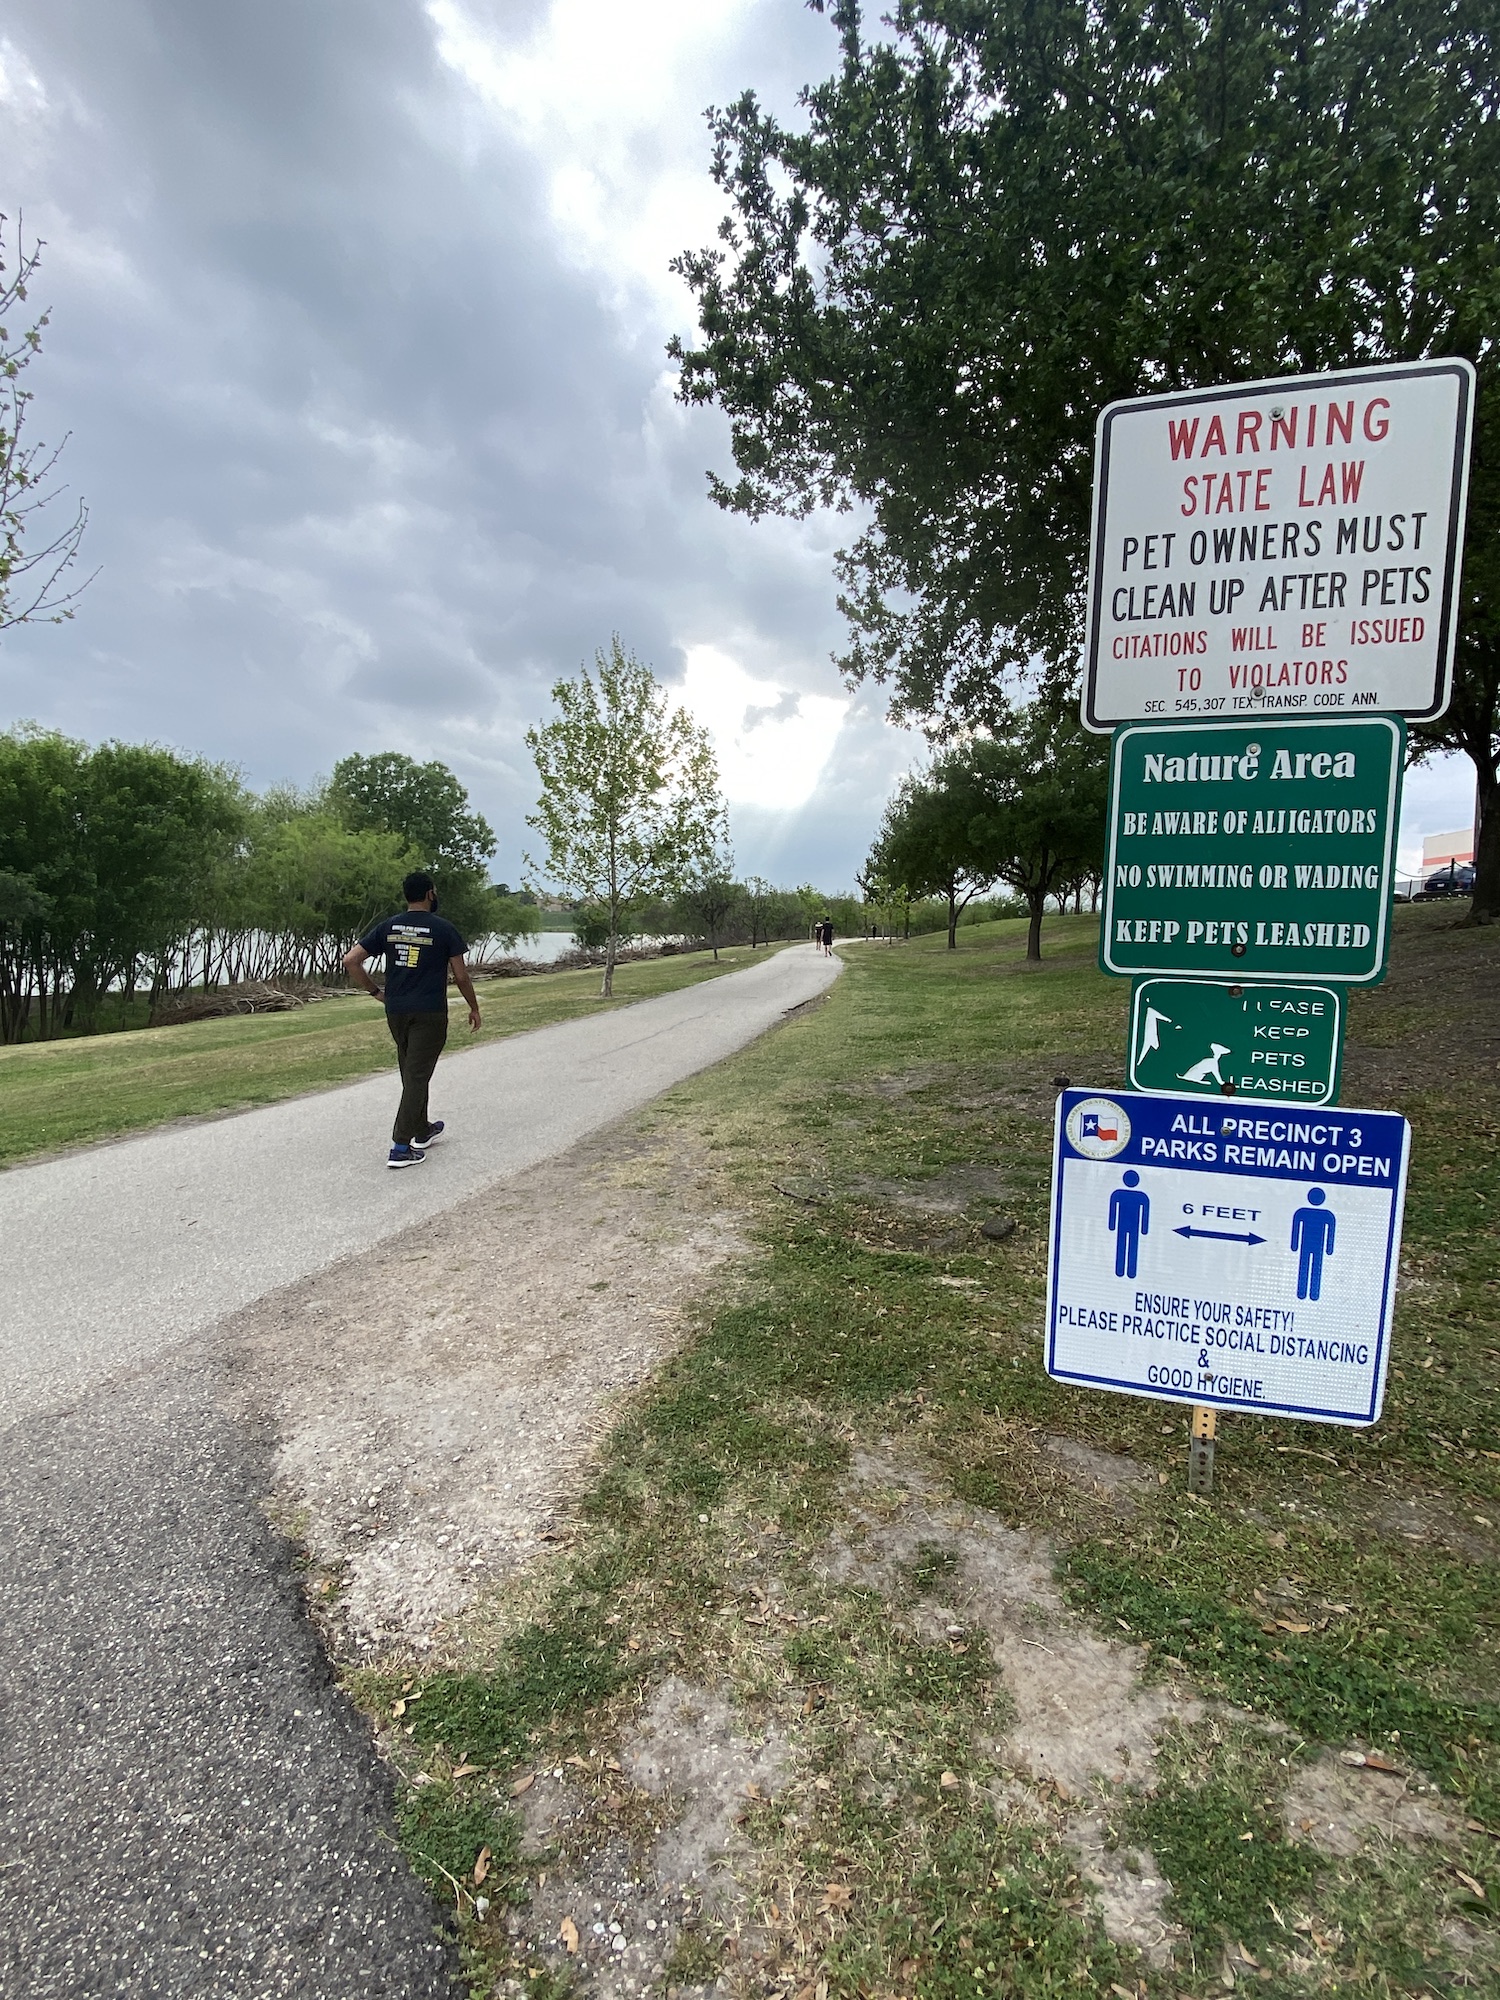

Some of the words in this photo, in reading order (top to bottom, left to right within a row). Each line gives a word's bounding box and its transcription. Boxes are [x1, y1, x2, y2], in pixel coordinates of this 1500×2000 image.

[1169, 398, 1391, 461] WARNING
[1181, 468, 1273, 516] STATE
[1298, 460, 1365, 508] LAW
[1122, 533, 1176, 572] PET
[1190, 520, 1322, 566] OWNERS
[1336, 512, 1427, 555] MUST
[1112, 582, 1196, 622] CLEAN
[1210, 578, 1244, 615] UP
[1259, 572, 1347, 612] AFTER
[1361, 566, 1432, 606] PETS
[1113, 630, 1207, 660] CITATIONS
[1232, 626, 1278, 651] WILL
[1302, 623, 1327, 648] BE
[1351, 617, 1425, 645] ISSUED
[1178, 668, 1201, 691] TO
[1229, 660, 1349, 689] VIOLATORS
[1144, 701, 1168, 713] SEC.
[1313, 693, 1345, 706] CODE
[1351, 692, 1381, 705] ANN.
[1142, 752, 1259, 783] Nature
[1269, 749, 1356, 780] Area
[1123, 812, 1147, 836] BE
[1151, 811, 1218, 835] AWARE
[1223, 810, 1248, 834] OF
[1116, 865, 1142, 888] NO
[1146, 864, 1254, 889] SWIMMING
[1259, 865, 1288, 889] OR
[1294, 865, 1379, 890] WADING
[1186, 920, 1249, 945] PETS
[1255, 922, 1371, 948] LEASHED
[1251, 1051, 1305, 1067] PETS
[1229, 1075, 1326, 1095] LEASHED
[1170, 1114, 1215, 1136] ALL
[1222, 1117, 1343, 1146] PRECINCT
[1348, 1128, 1362, 1148] 3
[1141, 1137, 1218, 1162] PARKS
[1224, 1143, 1316, 1172] REMAIN
[1322, 1153, 1392, 1178] OPEN
[1182, 1202, 1194, 1215] 6
[1202, 1205, 1262, 1222] FEET
[1135, 1292, 1189, 1318] ENSURE
[1194, 1300, 1231, 1325] YOUR
[1235, 1306, 1295, 1332] SAFETY!
[1059, 1305, 1117, 1332] PLEASE
[1122, 1314, 1201, 1344] PRACTICE
[1204, 1326, 1265, 1354] SOCIAL
[1270, 1335, 1369, 1365] DISTANCING
[1198, 1348, 1210, 1368] &
[1148, 1365, 1193, 1388] GOOD
[1197, 1372, 1266, 1399] HYGIENE.
